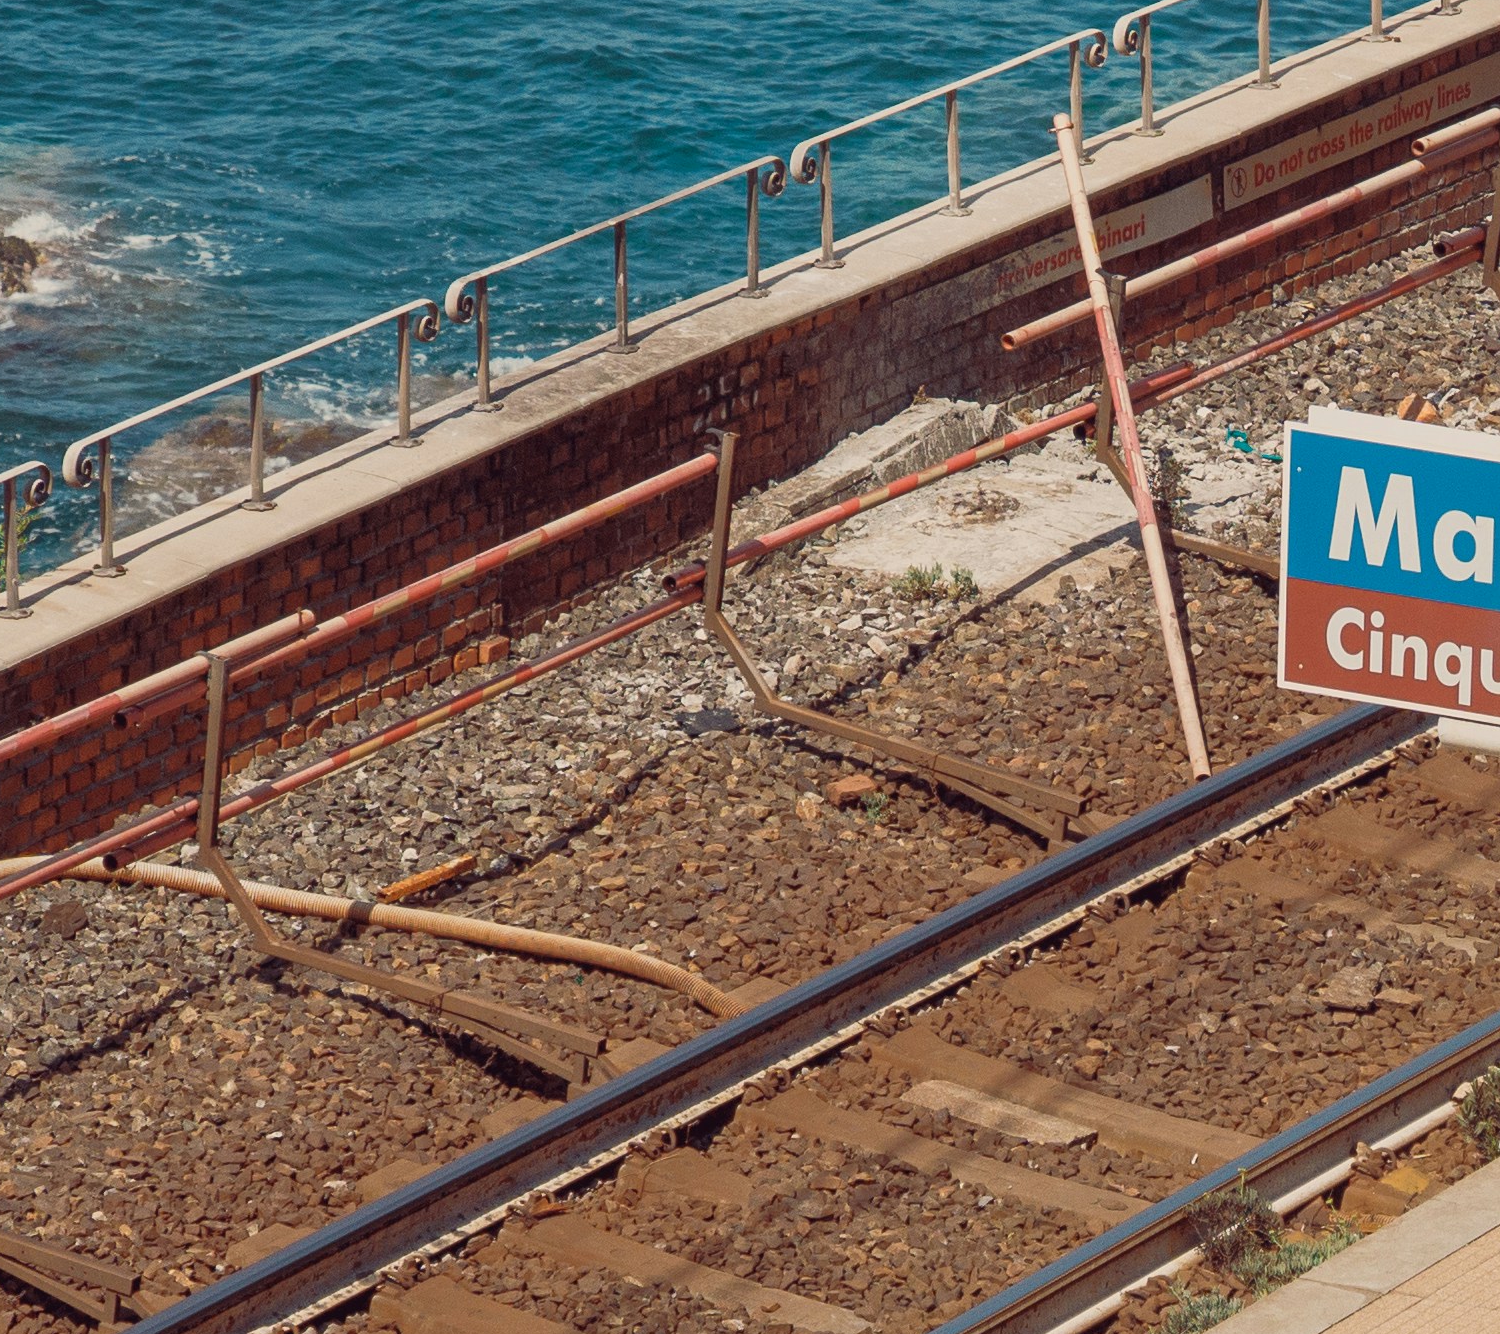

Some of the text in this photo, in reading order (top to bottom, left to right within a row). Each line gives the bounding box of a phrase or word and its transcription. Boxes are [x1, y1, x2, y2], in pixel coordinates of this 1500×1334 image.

[1254, 81, 1472, 188] Do not cross the railway lines
[1096, 213, 1145, 252] binari
